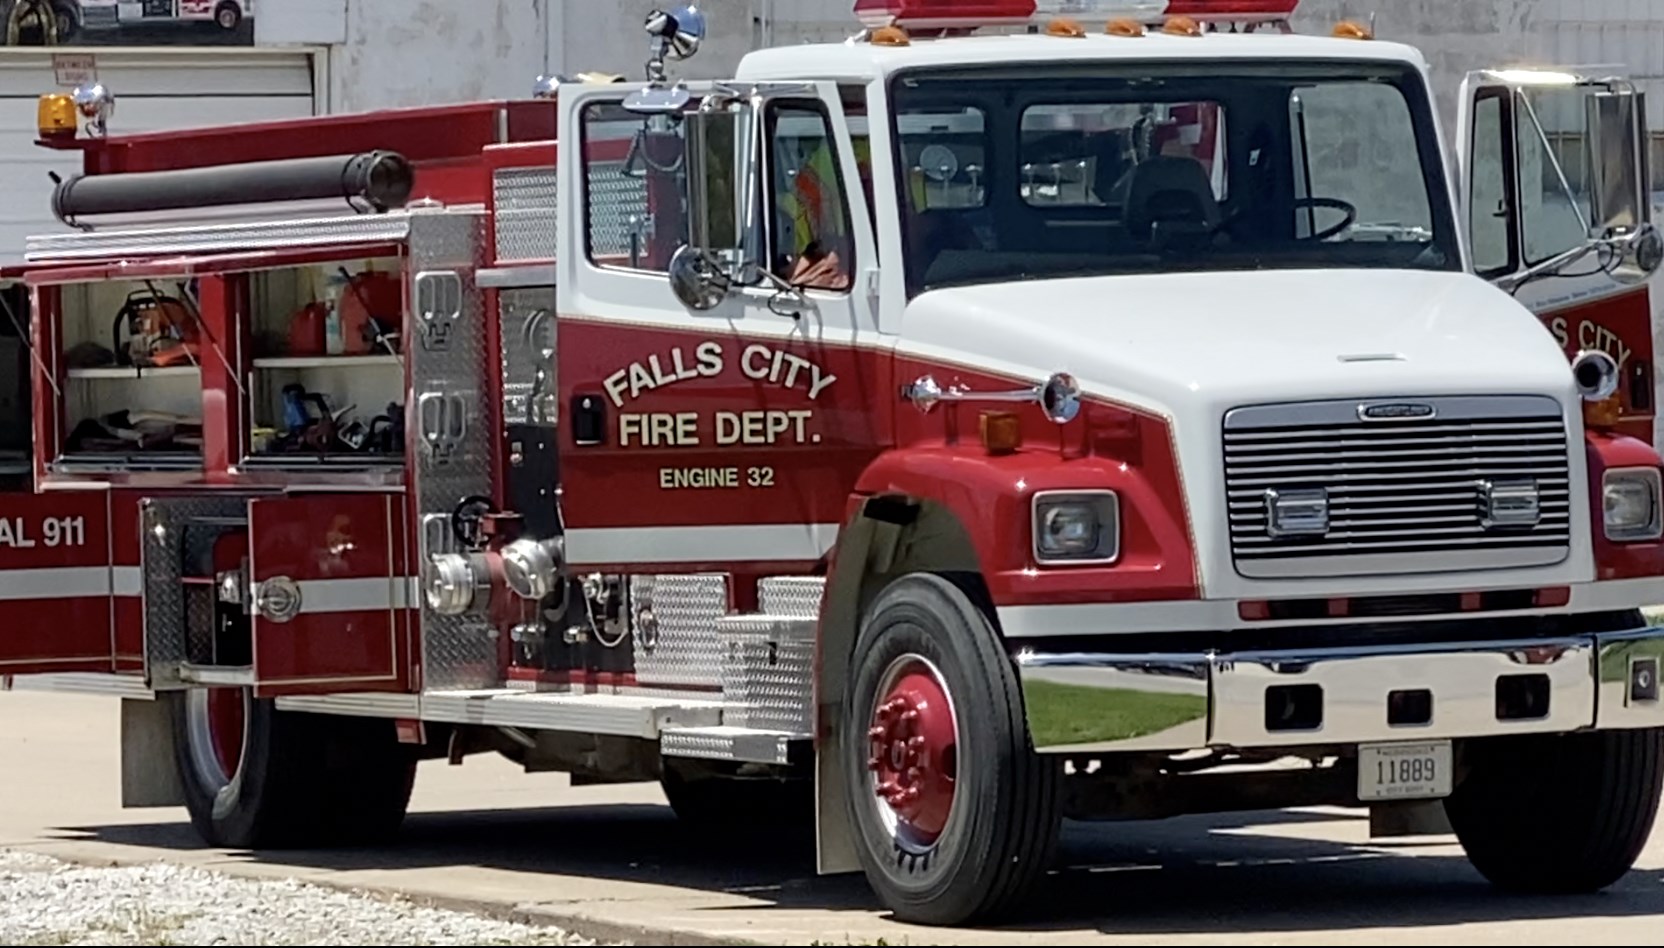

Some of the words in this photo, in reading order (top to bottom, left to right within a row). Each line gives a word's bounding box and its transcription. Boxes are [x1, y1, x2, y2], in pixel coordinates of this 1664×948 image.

[1578, 319, 1631, 371] CITY
[602, 341, 724, 408] FALLS
[741, 344, 837, 400] CITY
[619, 412, 699, 446] FIRE
[715, 410, 821, 444] DEPT.
[659, 467, 738, 488] ENGINE
[747, 466, 775, 487] 32
[0, 516, 36, 548] AL
[42, 515, 84, 547] 911
[1376, 758, 1435, 785] 11889
